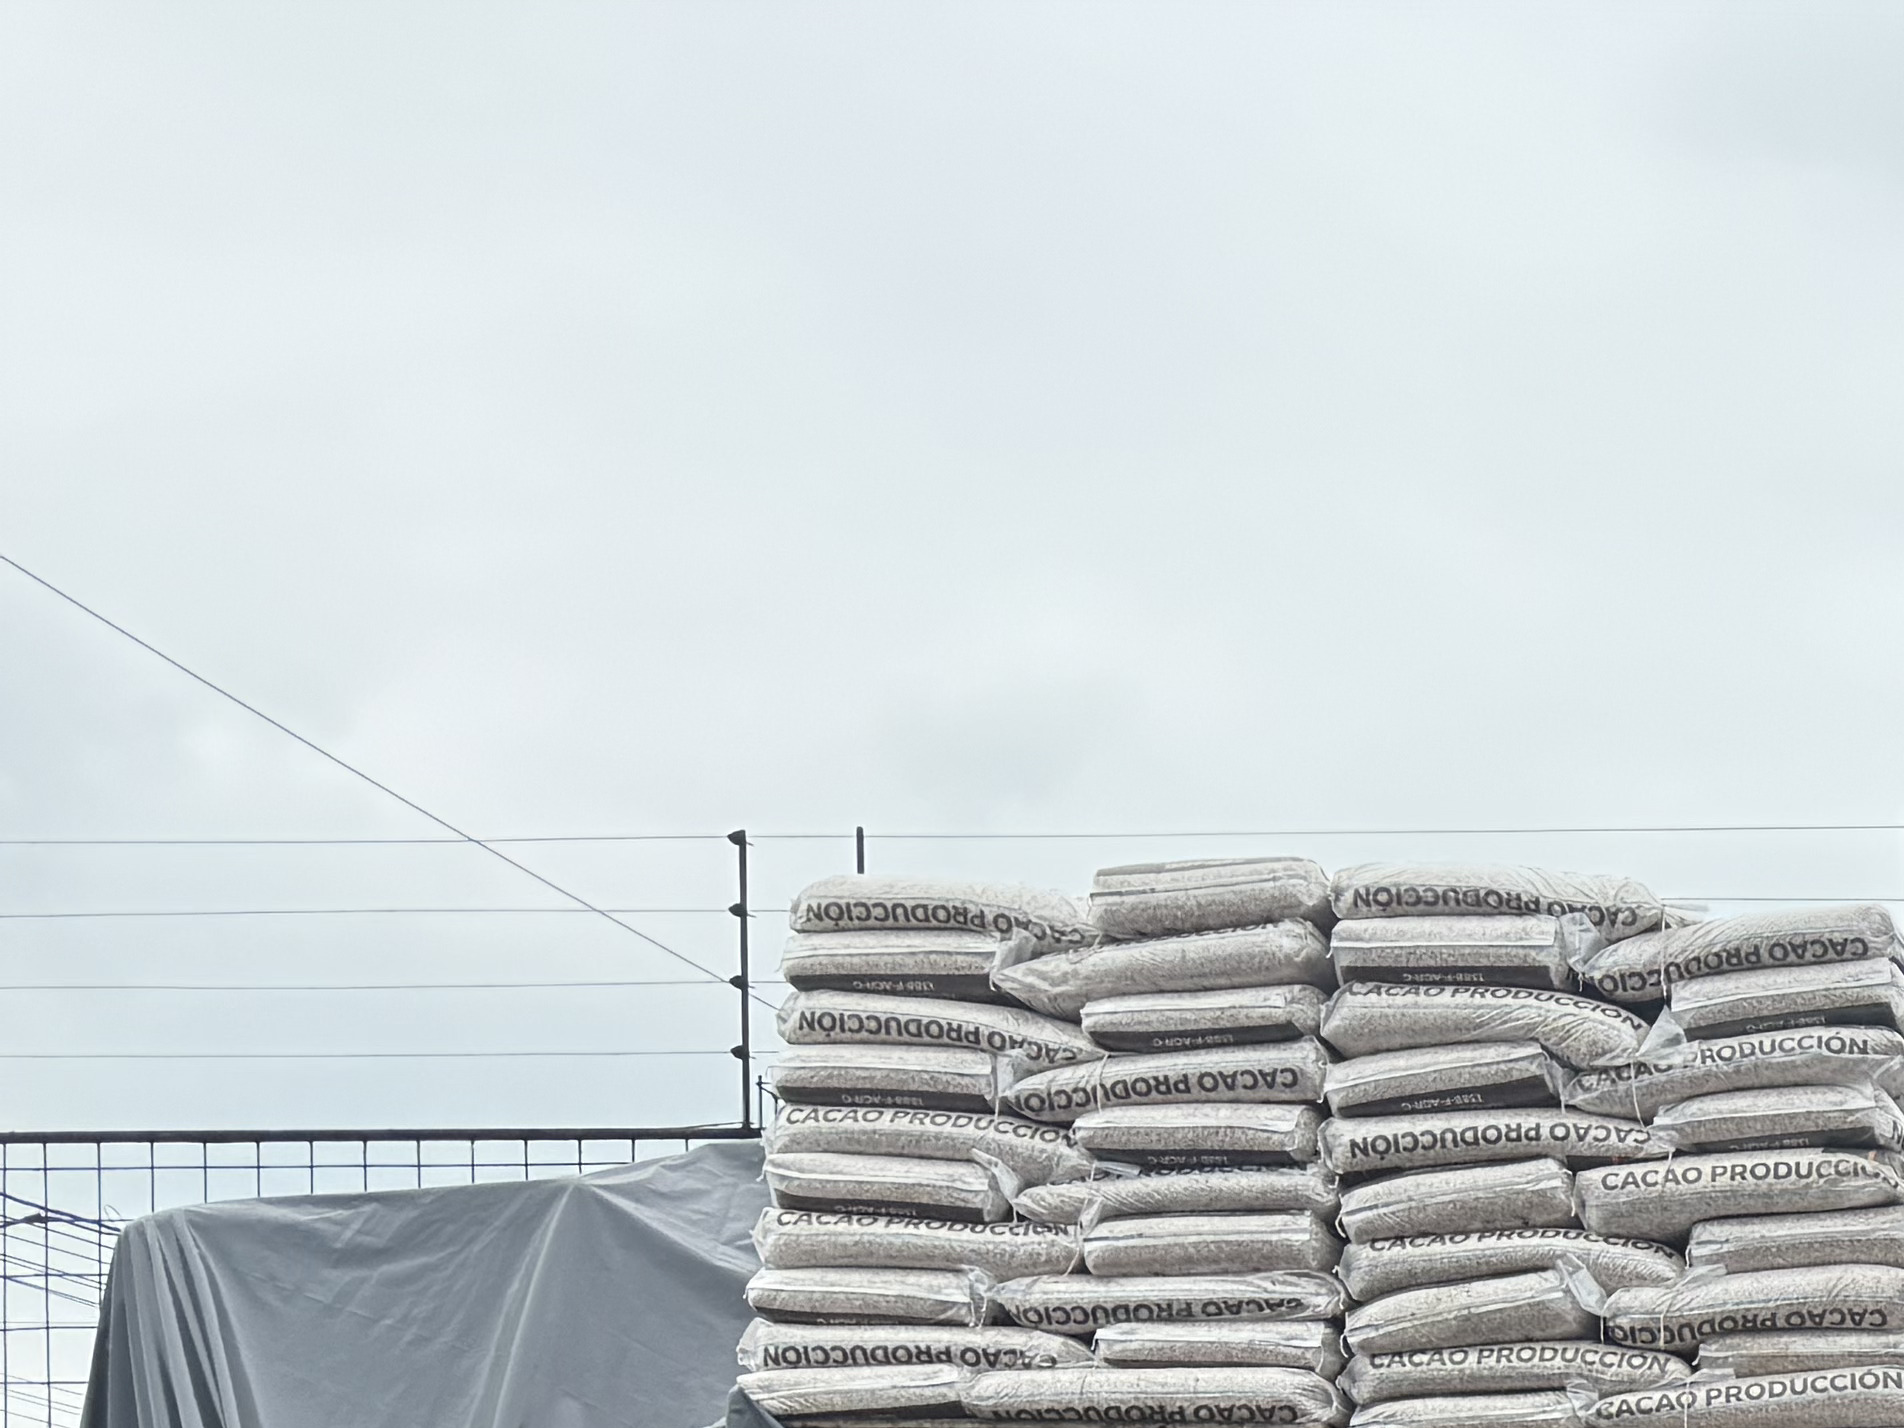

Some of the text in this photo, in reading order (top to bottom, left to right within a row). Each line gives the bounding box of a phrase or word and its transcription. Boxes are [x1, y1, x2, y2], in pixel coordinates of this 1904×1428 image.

[1768, 938, 1869, 961] CACAO
[1199, 1067, 1298, 1093] CACAO
[786, 1108, 883, 1125] CACAO
[1601, 1166, 1702, 1191] CACAO
[1784, 1307, 1888, 1328] CACAO
[1705, 1371, 1903, 1407] PRODUCCIÓN
